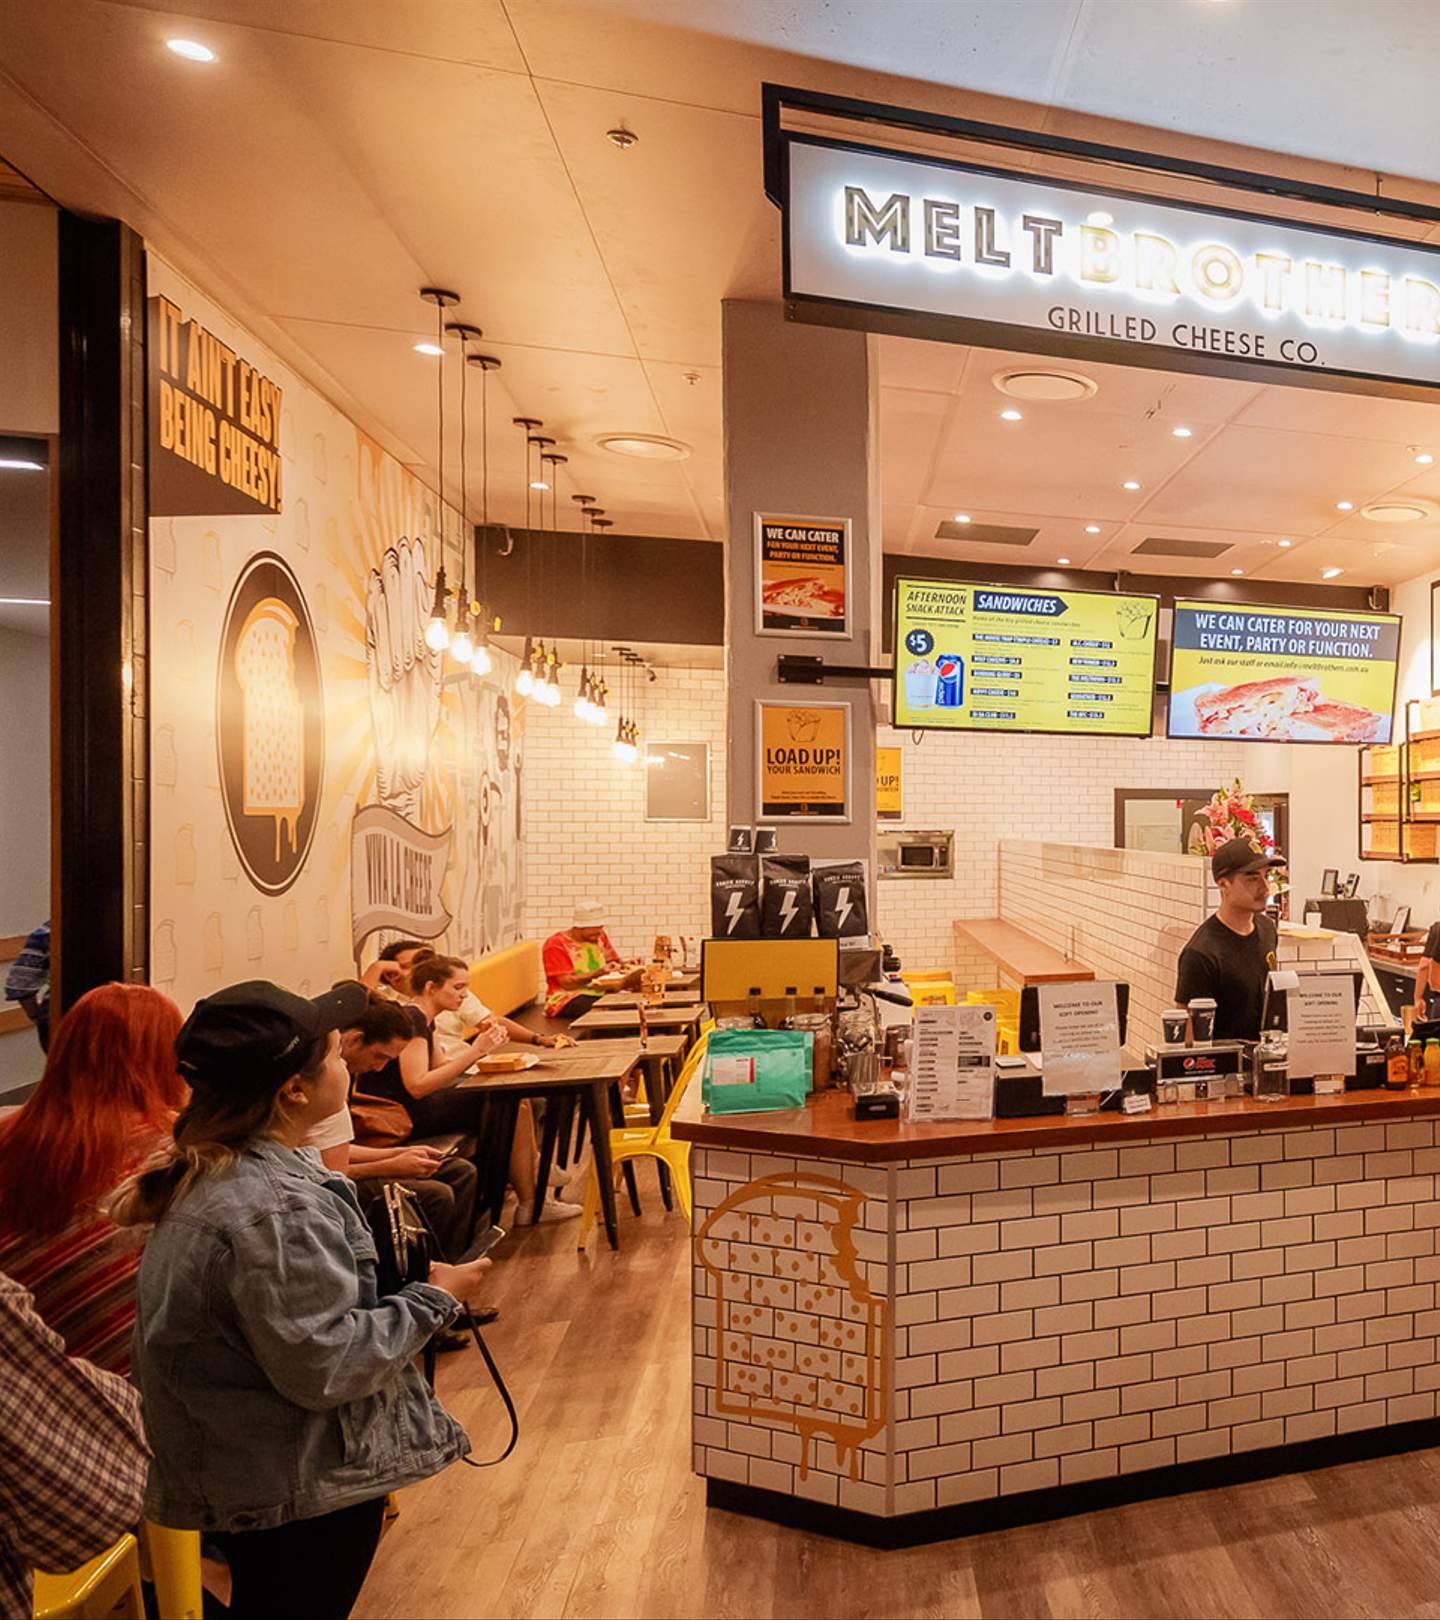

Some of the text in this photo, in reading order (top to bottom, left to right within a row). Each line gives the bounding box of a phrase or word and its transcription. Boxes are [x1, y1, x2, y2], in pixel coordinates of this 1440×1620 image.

[1047, 305, 1326, 366] GRILLED CHEESE CO.
[159, 294, 181, 380] IT
[239, 358, 283, 449] EASY
[159, 379, 282, 513] BEING CHEESY!
[766, 527, 839, 544] WE CAN CATER
[907, 590, 967, 606] AFTERNOON
[977, 594, 1057, 614] SANDWICHES
[905, 603, 965, 616] SNACK ATTACK
[1195, 613, 1380, 640] WE CAN CATER FOR YOUR NEXT
[909, 633, 927, 652] $5
[1200, 633, 1373, 658] EVENT, PARTY OR FUNCTION.
[767, 748, 841, 765] LOAD UP!
[767, 765, 841, 776] YOUR SANDWICH
[881, 776, 899, 787] UP!
